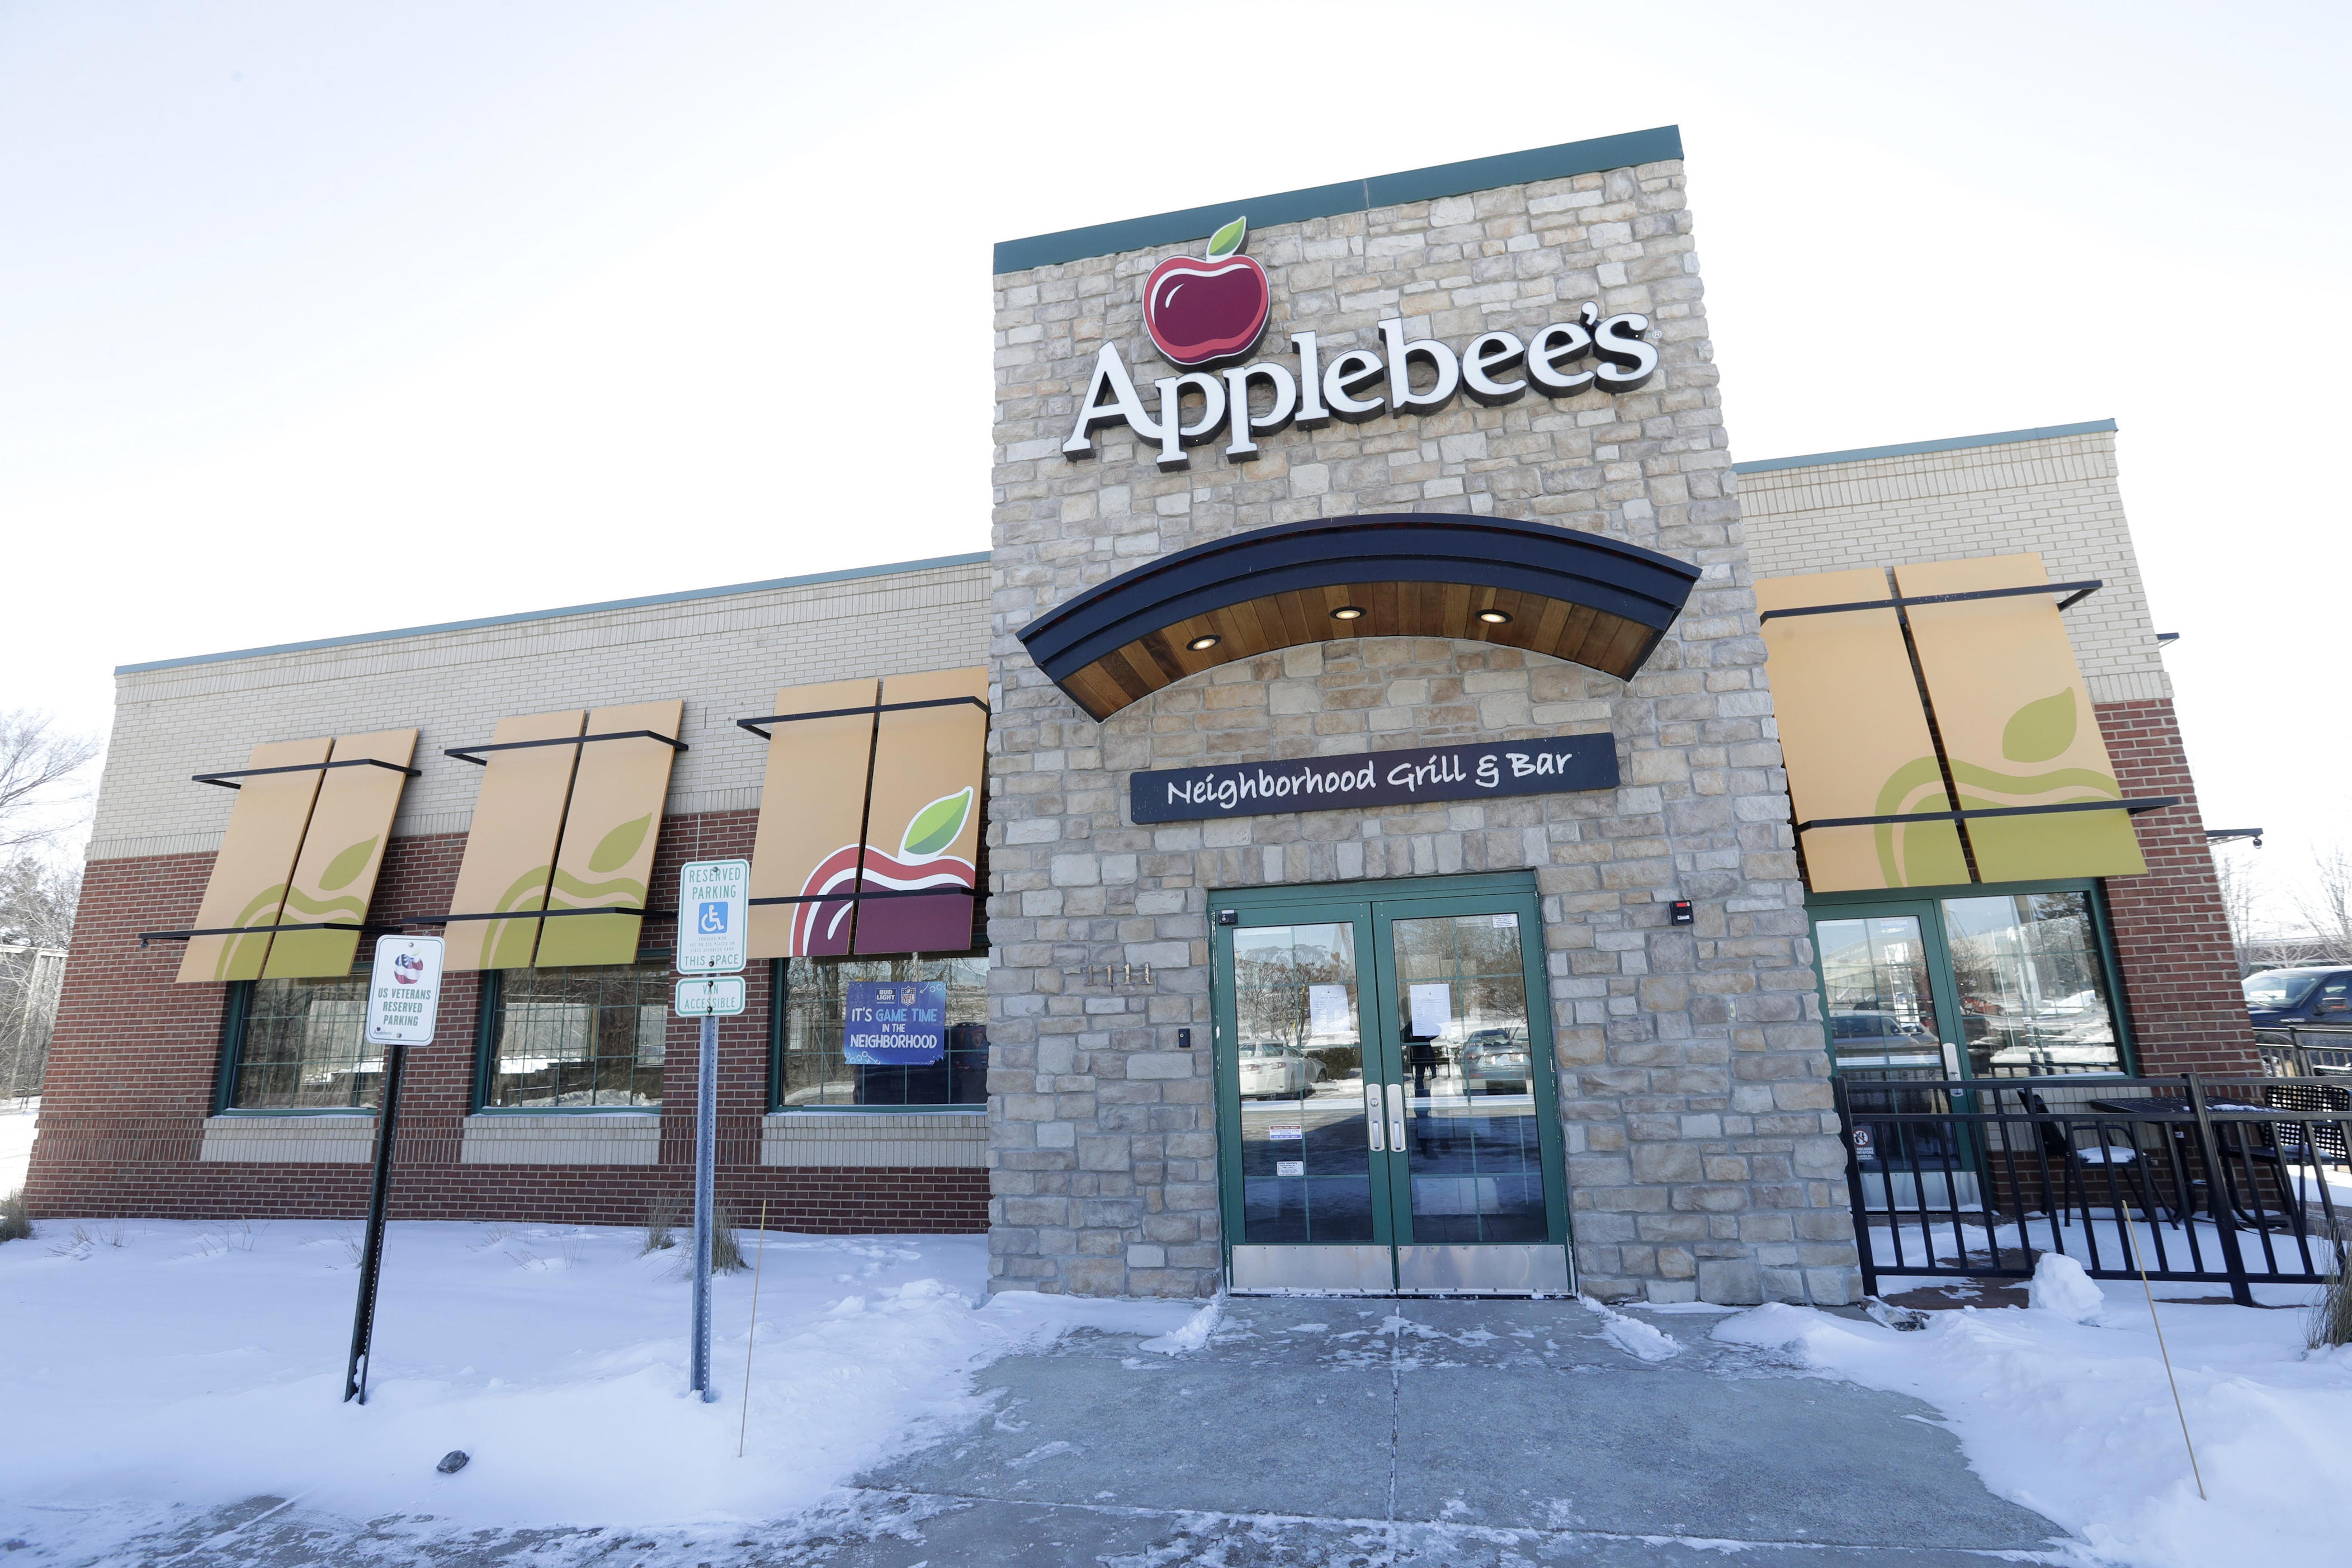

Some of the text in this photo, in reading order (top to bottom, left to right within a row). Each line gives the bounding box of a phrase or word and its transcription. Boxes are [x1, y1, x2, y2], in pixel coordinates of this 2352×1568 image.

[1063, 300, 1659, 471] Applebee's
[1167, 752, 1572, 809] Neighborhood Grill & Bar
[689, 867, 740, 883] RESERVED
[692, 885, 736, 900] PARKING
[684, 954, 739, 966] THIS SPACE
[378, 988, 431, 1000] US VETERANS
[703, 984, 719, 995] VAN
[382, 1001, 423, 1013] RESERVED
[684, 997, 735, 1009] ACCESSIBLE
[383, 1015, 418, 1026] PARKING
[852, 1007, 938, 1022] IT'S GAME TIME
[882, 1023, 905, 1032] IN THE
[850, 1034, 937, 1049] NEIGHBORHOOD
